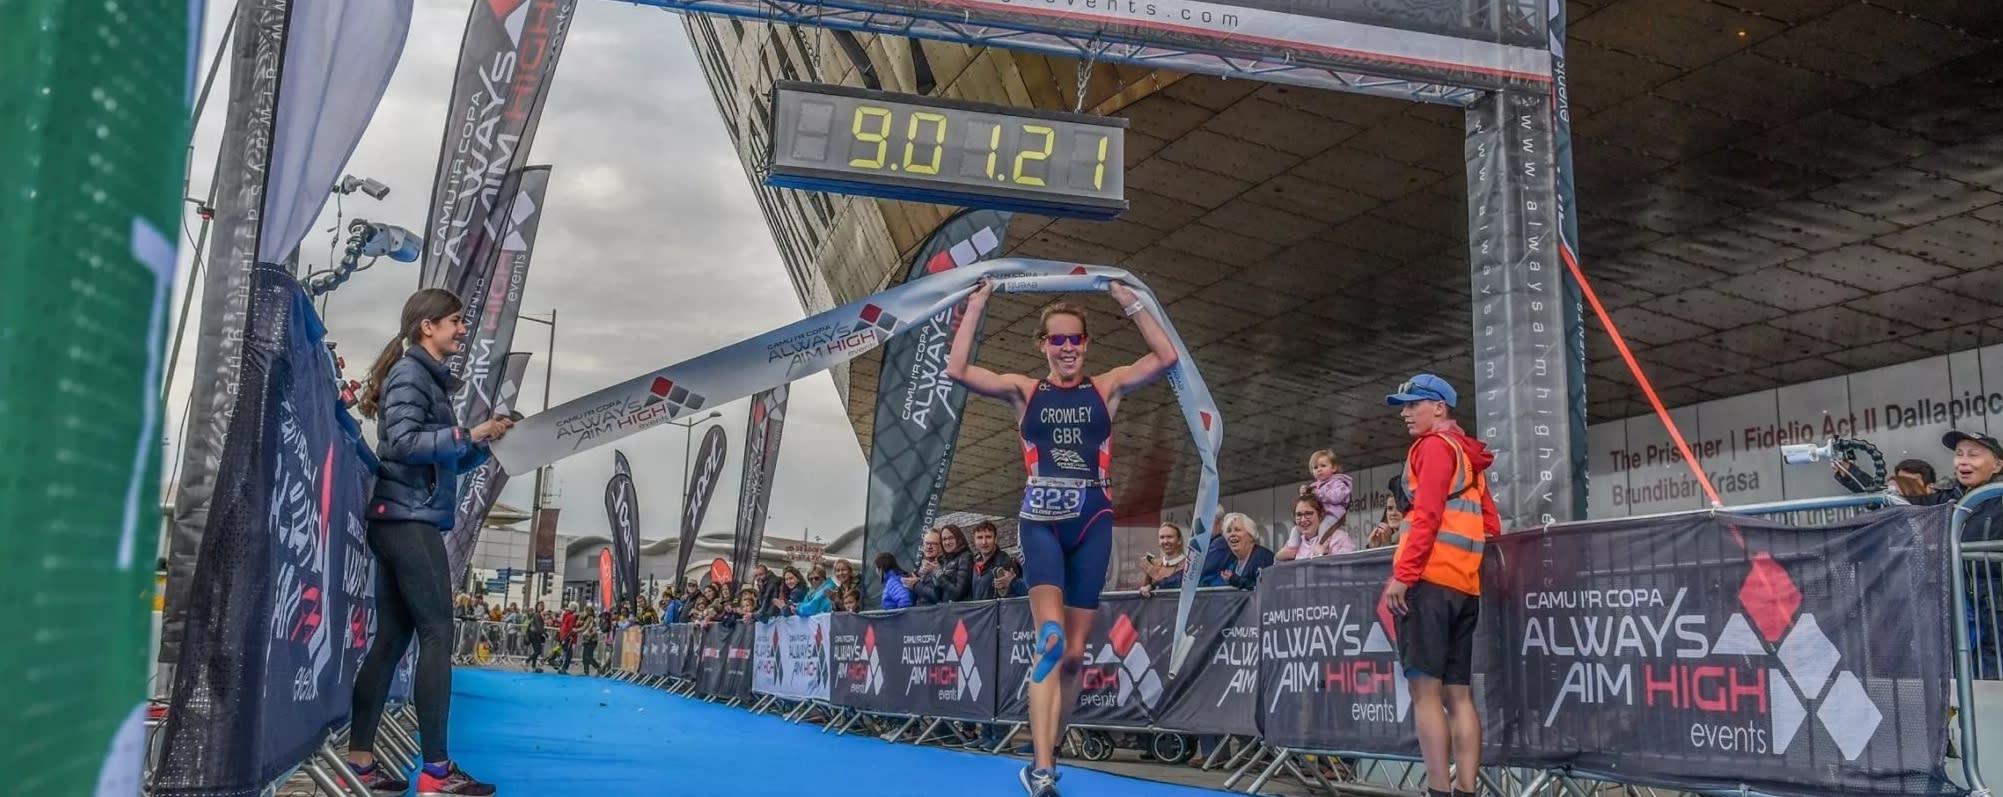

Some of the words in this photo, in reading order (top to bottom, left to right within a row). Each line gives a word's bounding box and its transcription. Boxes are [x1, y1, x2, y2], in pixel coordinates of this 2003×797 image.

[504, 1, 556, 120] HIGH
[433, 190, 457, 256] CAMU
[458, 91, 483, 152] COPA
[445, 51, 517, 266] ALWAYS
[508, 254, 527, 302] events
[768, 321, 851, 363] ALWAYS
[785, 348, 823, 377] AIM
[826, 330, 875, 354] HIGH
[472, 338, 496, 410] AIM
[902, 381, 917, 421] CAMU
[915, 325, 931, 362] COPA
[911, 307, 953, 430] ALWAYS
[556, 395, 642, 440] ALWAYS
[573, 422, 613, 451] AIM
[617, 404, 668, 430] HIGH
[1040, 406, 1092, 424] CROWLEY
[1052, 427, 1084, 445] GBR
[1610, 450, 1641, 473] The
[1646, 438, 1723, 465] Prisner
[1744, 420, 1813, 452] Fidelio
[1821, 413, 1857, 437] Act
[1029, 487, 1081, 510] 323
[1612, 474, 1697, 506] Brundibár
[1262, 607, 1290, 625] CAMU
[1306, 605, 1338, 621] COPA
[1525, 590, 1578, 609] CAMU
[1580, 589, 1603, 608] I'R
[1606, 587, 1665, 608] COPA
[1262, 604, 1361, 660] ALWAYS
[1521, 587, 1706, 658] ALWAYS
[833, 635, 860, 661] ALWAYS
[901, 633, 946, 665] ALWAYS
[1269, 661, 1320, 714] AIM
[1325, 660, 1394, 695] HIGH
[1351, 698, 1395, 723] events
[1544, 662, 1634, 728] AIM
[1645, 663, 1768, 715] HIGH
[1690, 721, 1768, 755] events
